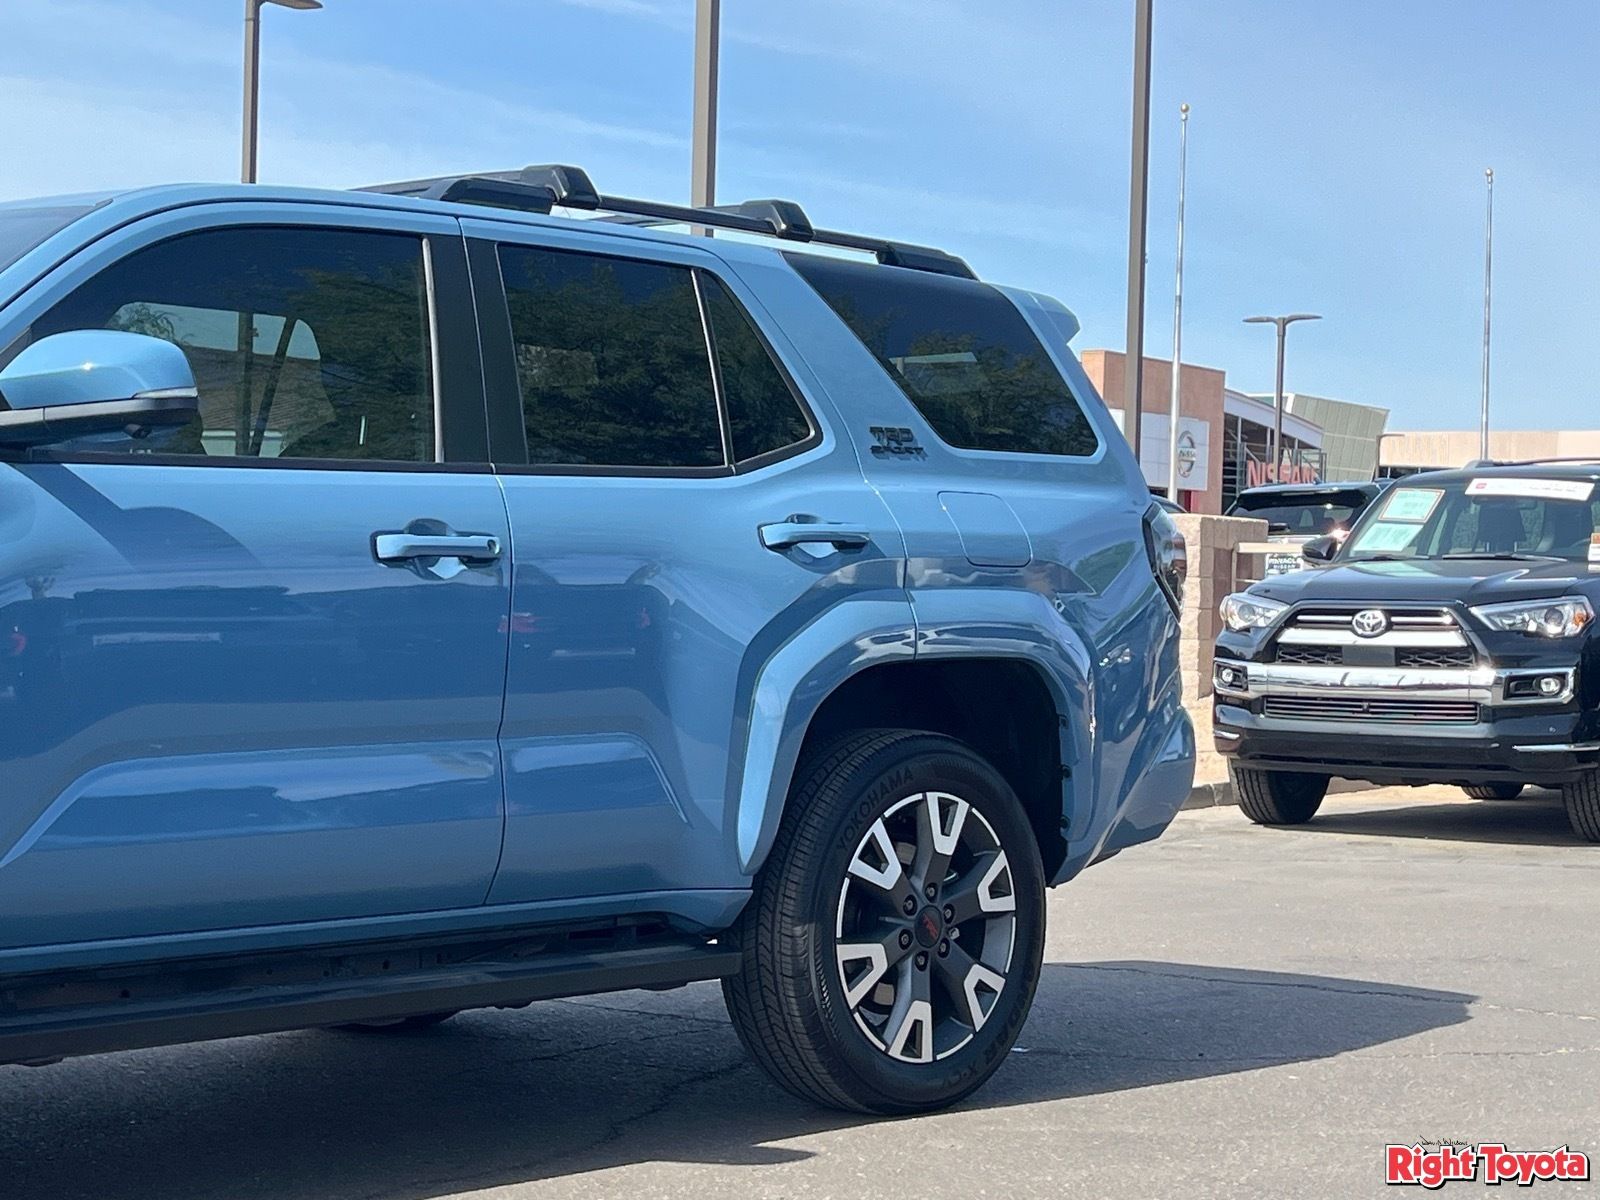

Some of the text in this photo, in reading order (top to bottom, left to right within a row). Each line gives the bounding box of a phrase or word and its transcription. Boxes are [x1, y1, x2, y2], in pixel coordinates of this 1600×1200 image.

[869, 426, 915, 444] TRD
[870, 445, 927, 460] SPORT
[1247, 460, 1319, 486] NISSAN
[836, 766, 914, 851] YOKOHAMA
